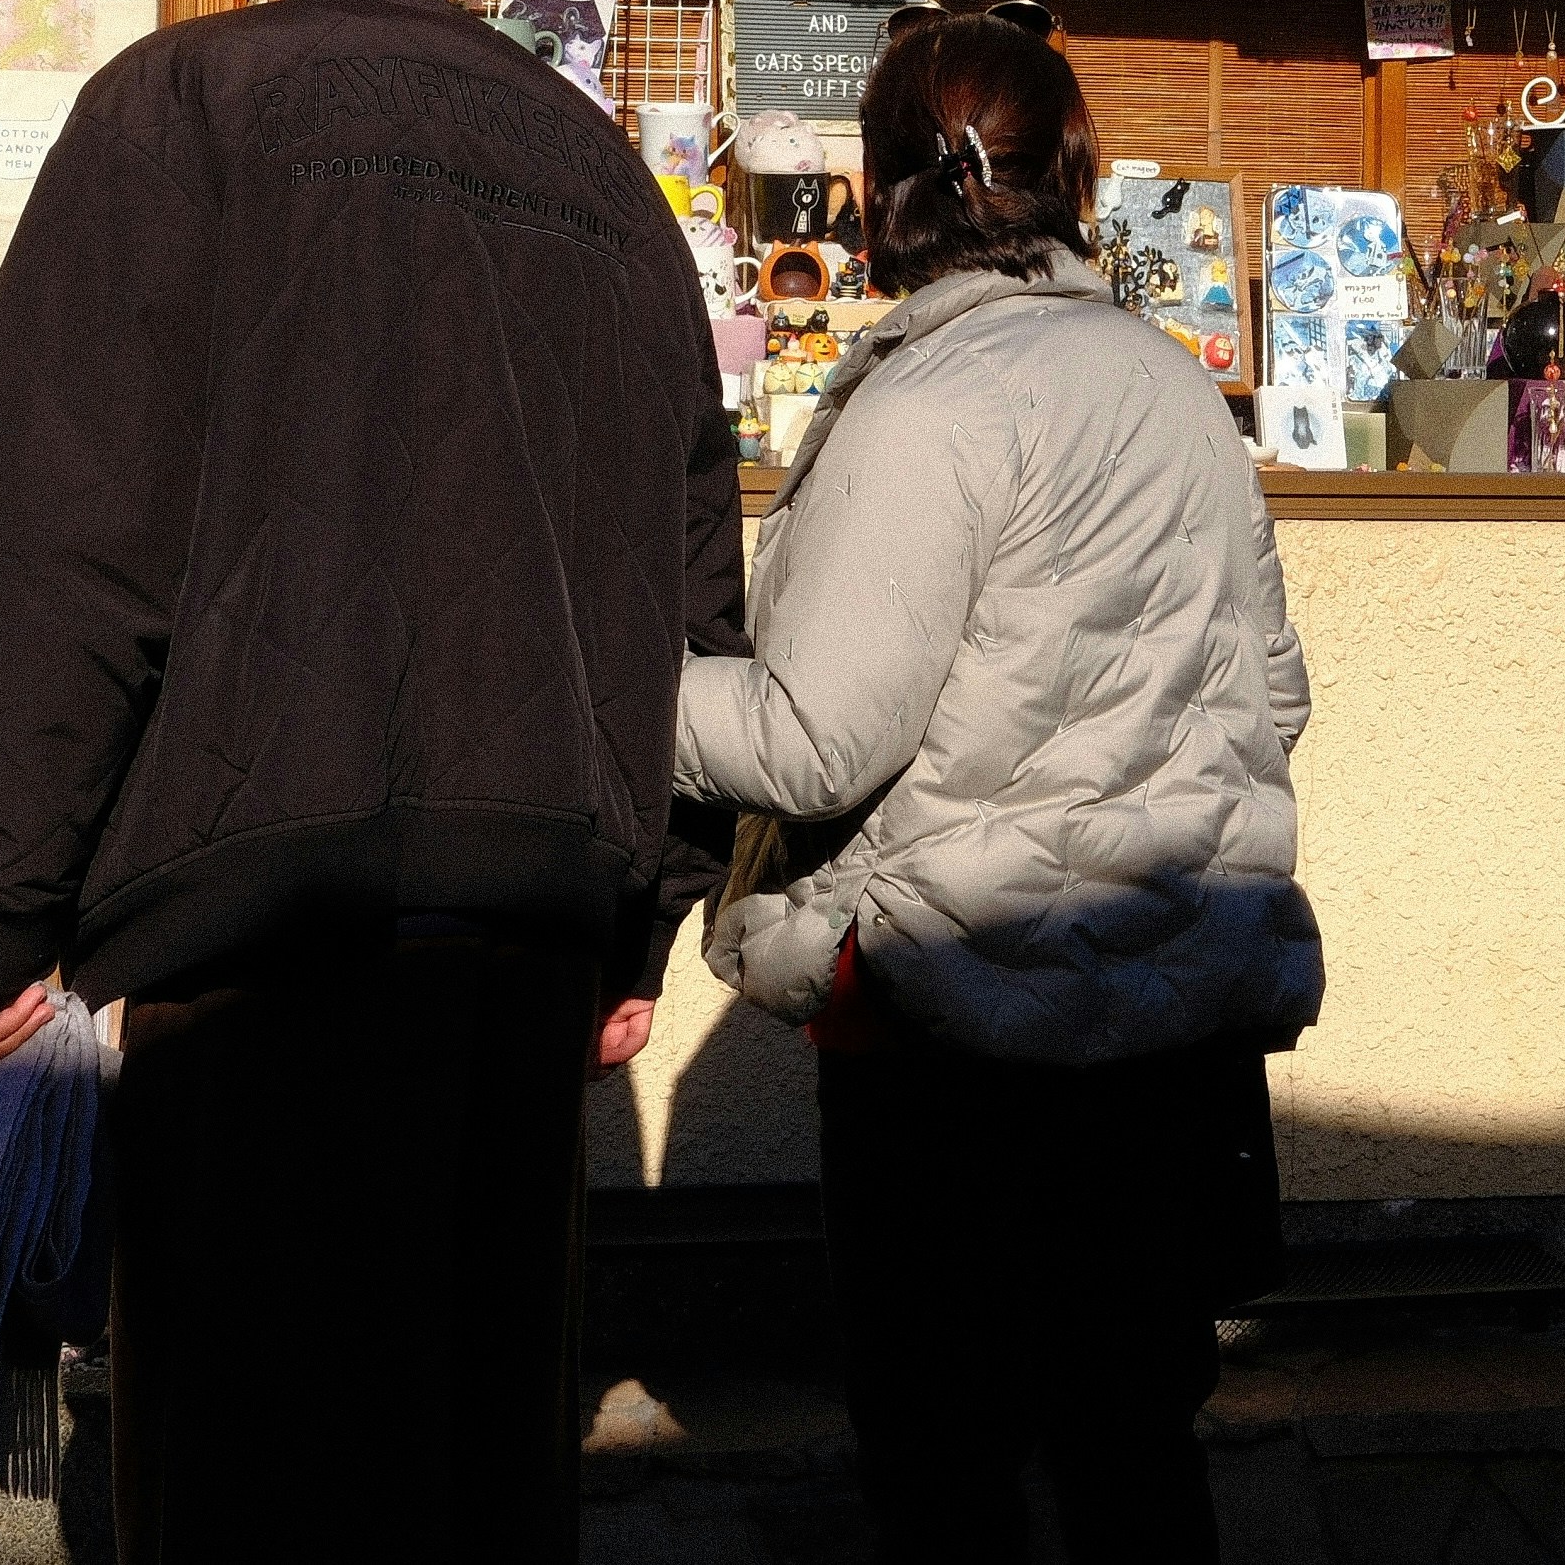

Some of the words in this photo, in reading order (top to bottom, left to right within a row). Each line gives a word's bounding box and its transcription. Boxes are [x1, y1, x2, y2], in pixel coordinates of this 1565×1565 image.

[808, 14, 848, 33] AND
[754, 53, 803, 72] CATS
[803, 79, 867, 97] GIFTS
[4, 158, 33, 169] MEW
[291, 155, 445, 185] PRODUCED
[447, 169, 555, 218] CURRENT
[559, 202, 631, 253] UTILITY
